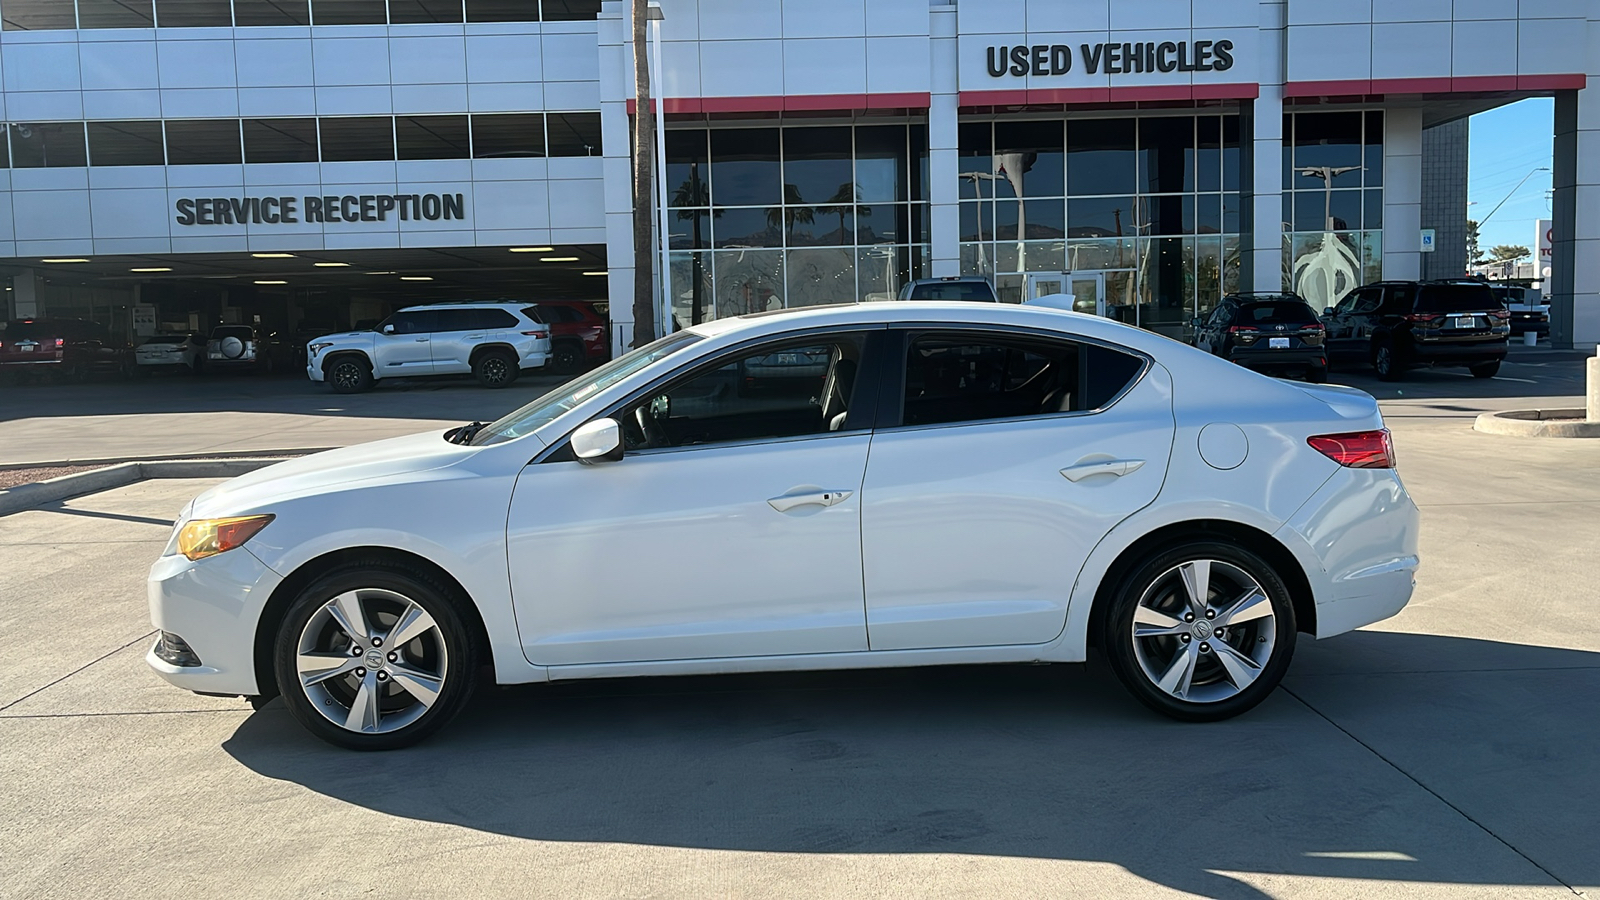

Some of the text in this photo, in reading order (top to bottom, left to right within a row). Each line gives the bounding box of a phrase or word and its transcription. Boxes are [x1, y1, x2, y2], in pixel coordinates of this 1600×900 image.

[986, 40, 1234, 77] USED VEHICLES
[176, 193, 464, 226] SERVICE RECEPTION
